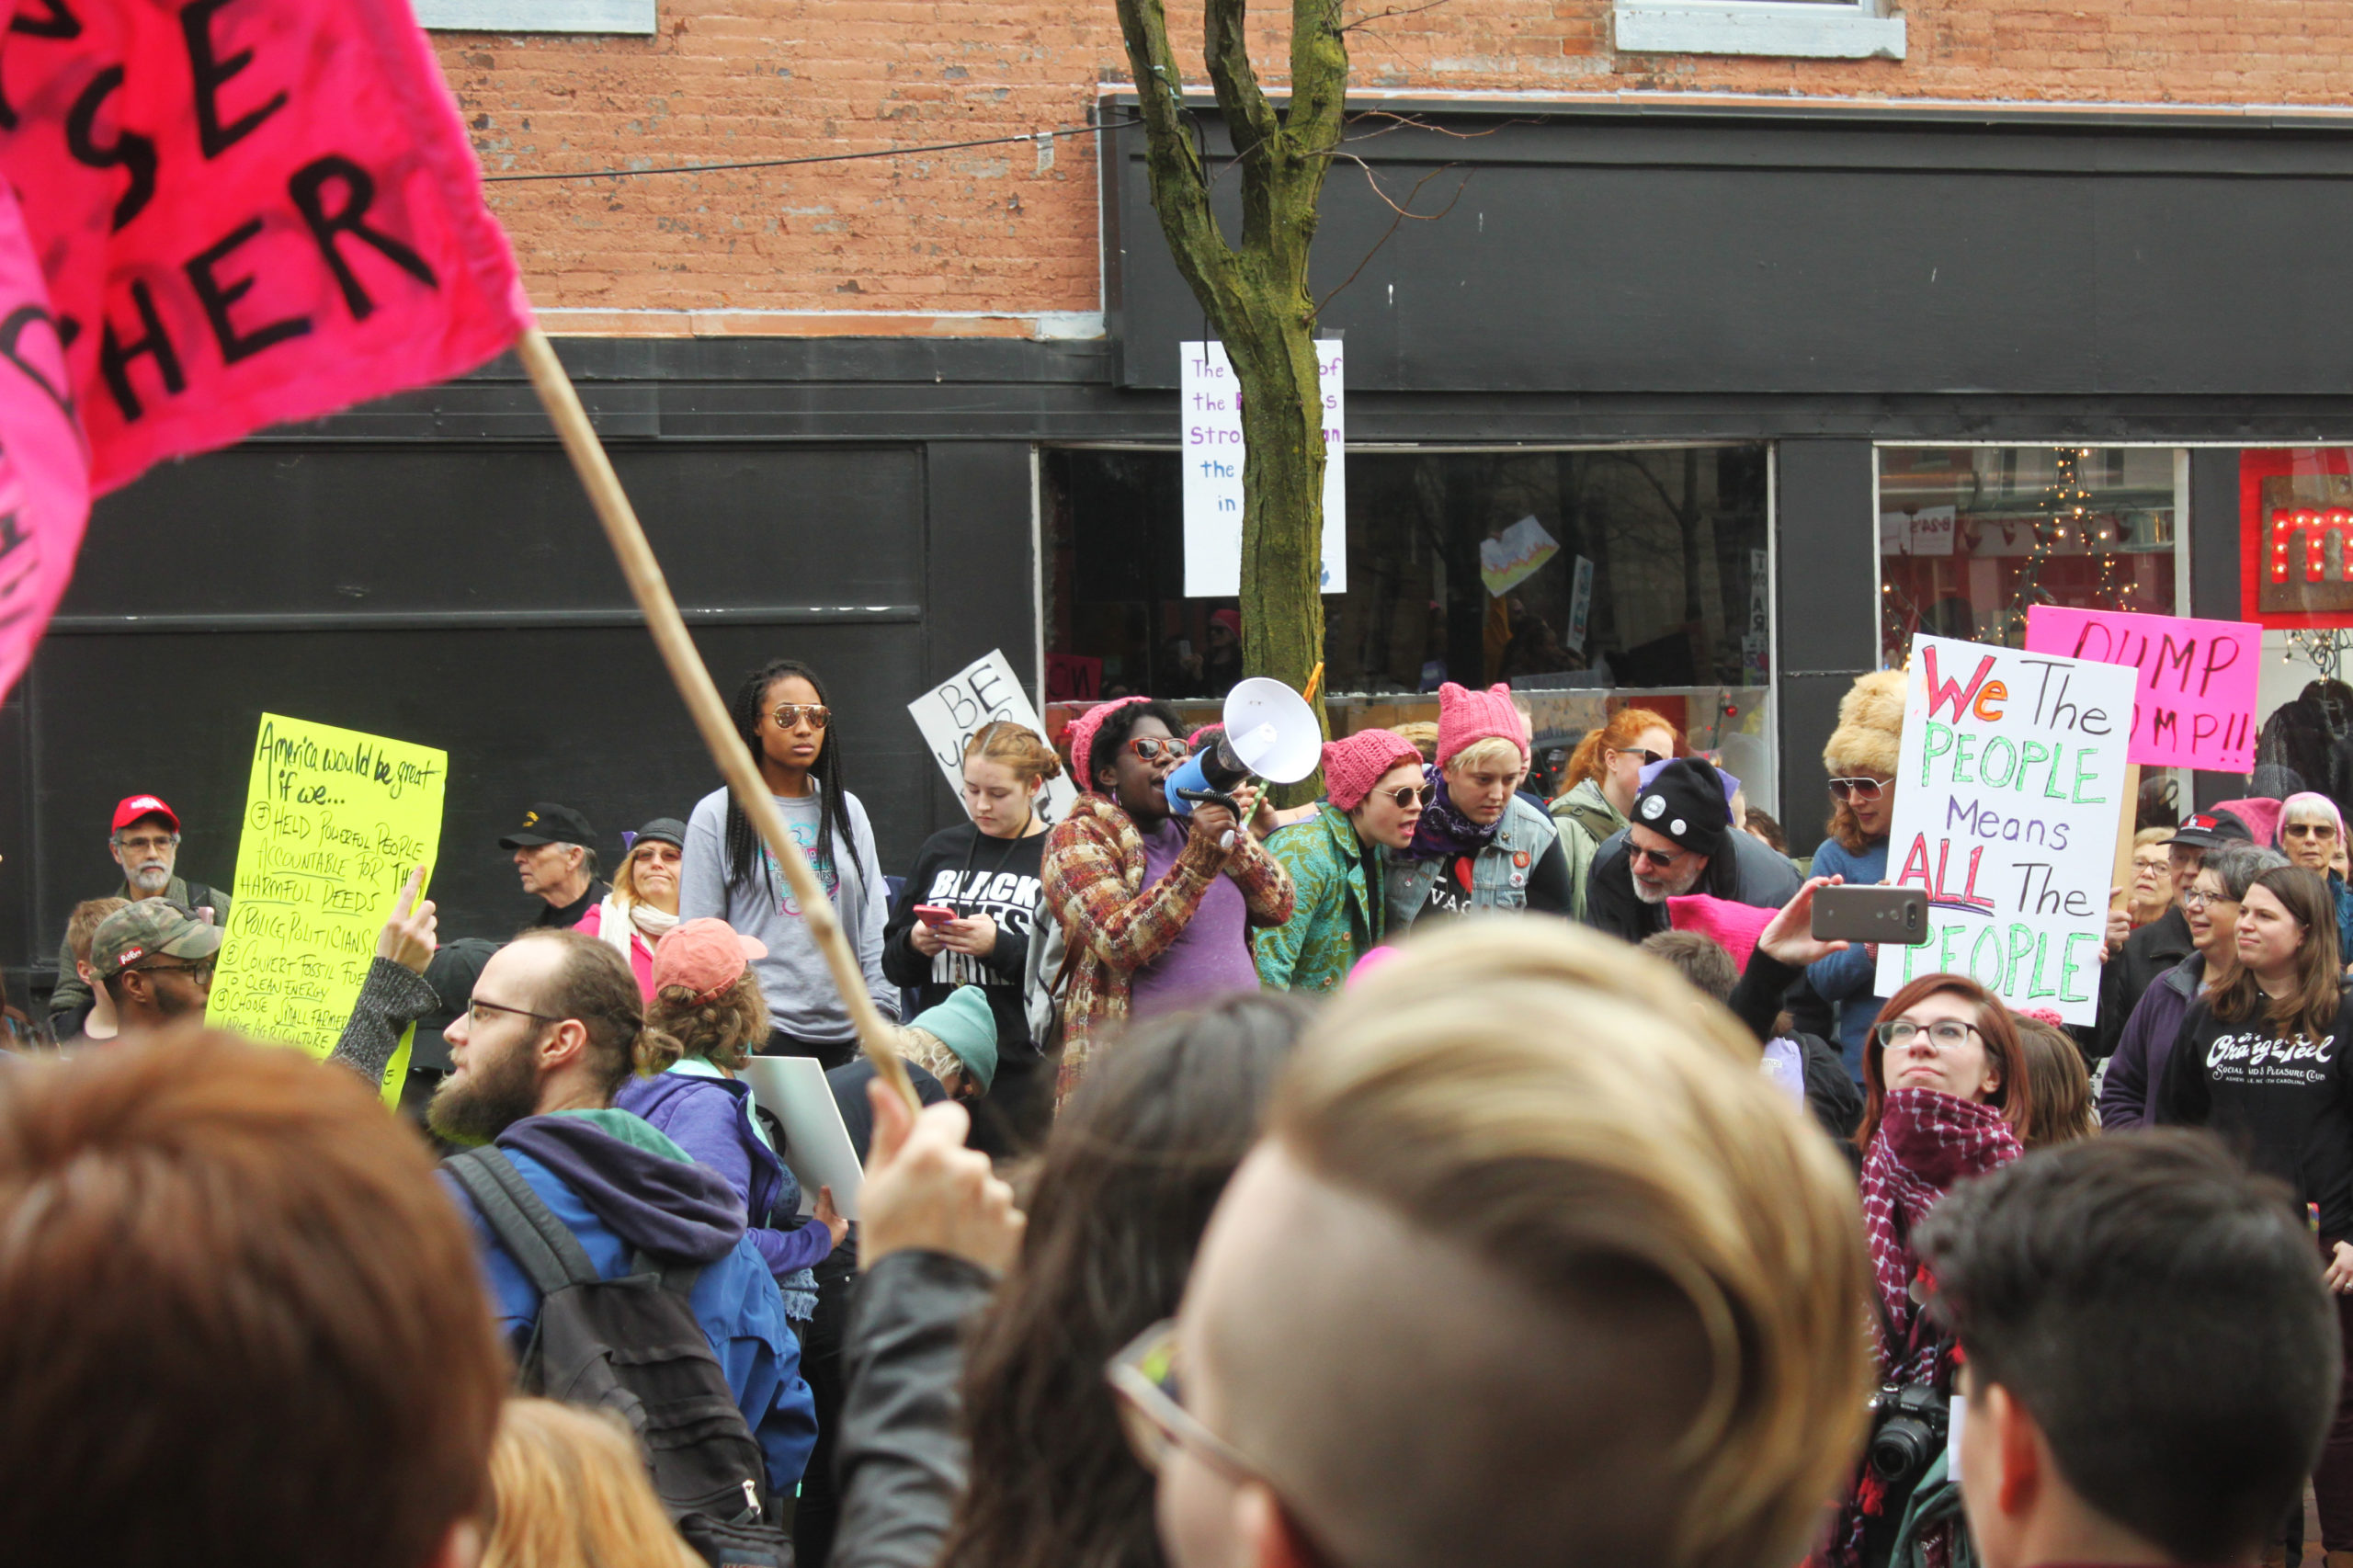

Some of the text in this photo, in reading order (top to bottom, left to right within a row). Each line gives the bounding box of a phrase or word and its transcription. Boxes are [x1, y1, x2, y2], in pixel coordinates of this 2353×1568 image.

[60, 153, 439, 423] HER
[1191, 359, 1224, 378] The
[1193, 392, 1225, 411] the
[1200, 460, 1234, 478] the
[1218, 495, 1236, 511] in
[2074, 621, 2239, 698] DUMP
[938, 664, 1013, 729] BE
[1922, 645, 2112, 735] We The
[2129, 702, 2249, 763] MP!!
[259, 721, 442, 800] America would be great
[279, 769, 298, 802] if
[1921, 720, 2106, 804] PEOPLE
[273, 805, 311, 840] HELD
[375, 822, 425, 861] PEOPLE
[1947, 794, 2071, 850] Means
[256, 837, 353, 876] ACCOUNTABLE
[355, 851, 384, 886] FOR
[1897, 832, 2095, 915] ALL The
[240, 874, 381, 912] HARMFUL DEEDS
[928, 869, 1041, 910] BLACK
[220, 970, 330, 999] TO CLEAN ENERGY
[240, 940, 297, 973] CONVERT
[297, 953, 334, 980] FOSSIL
[343, 961, 368, 986] FUE
[1904, 923, 2099, 1002] PEOPLE
[230, 992, 267, 1013] CHOOSE
[274, 997, 308, 1027] SMALL
